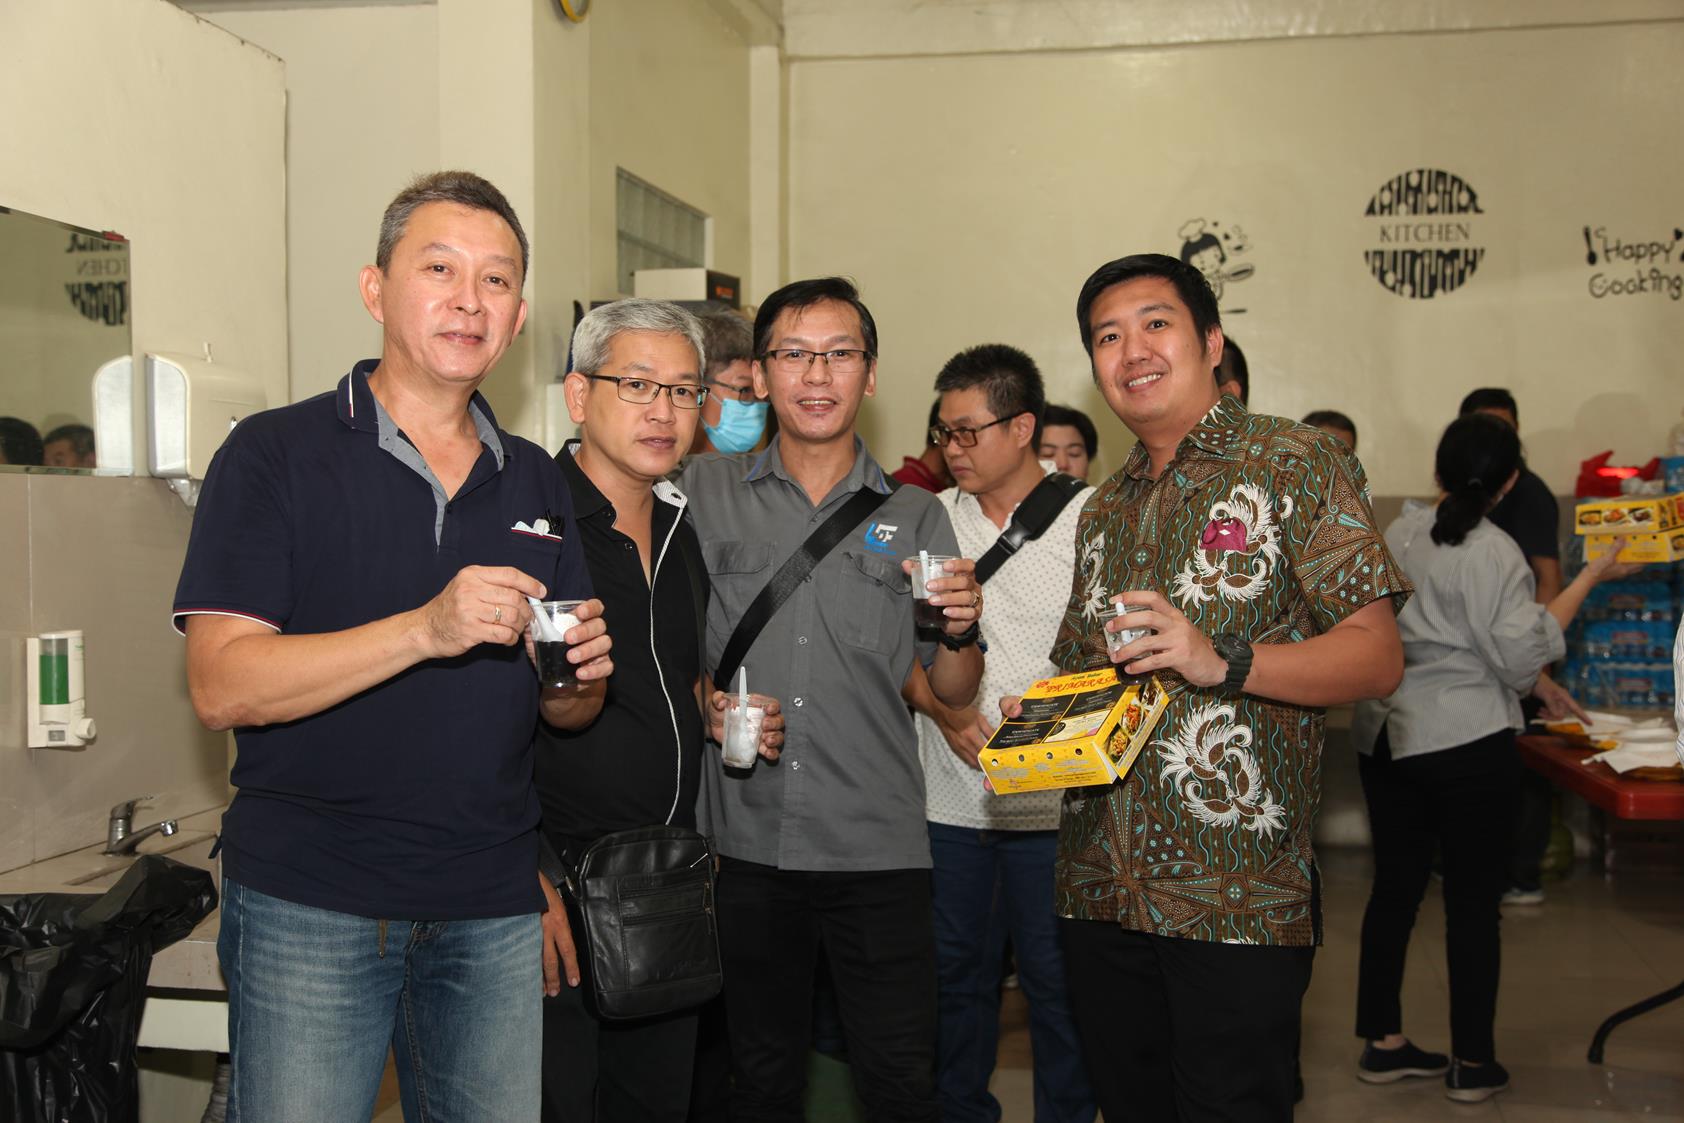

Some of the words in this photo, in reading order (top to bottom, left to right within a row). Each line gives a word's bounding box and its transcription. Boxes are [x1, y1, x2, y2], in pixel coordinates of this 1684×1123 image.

[1380, 223, 1470, 243] KITCHEN
[1595, 226, 1675, 264] Happy
[1588, 267, 1683, 301] Cooking
